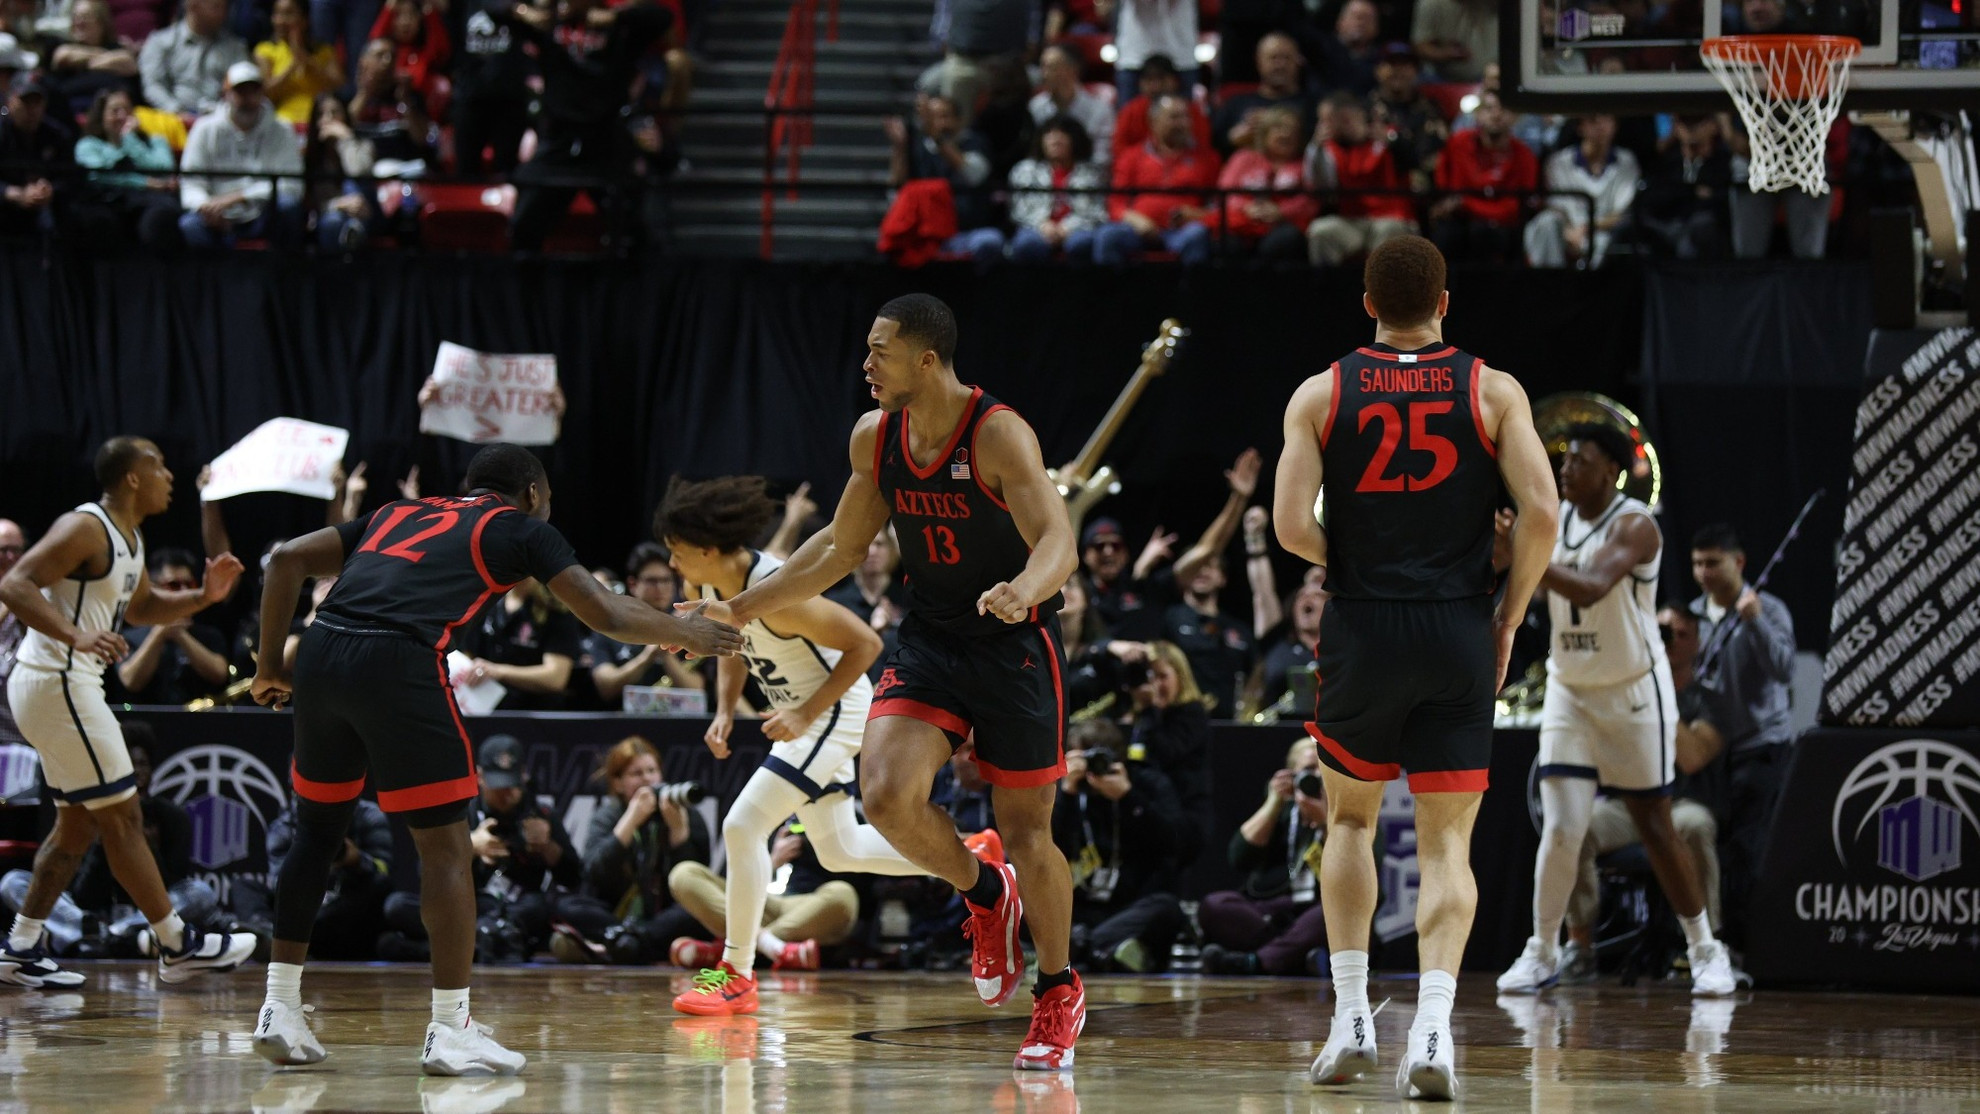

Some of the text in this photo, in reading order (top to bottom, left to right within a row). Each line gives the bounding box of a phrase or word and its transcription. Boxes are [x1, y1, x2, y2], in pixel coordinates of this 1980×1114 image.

[498, 358, 556, 385] JUST
[1360, 368, 1453, 393] SAUNDERS
[1853, 375, 1901, 442] NESS
[1354, 401, 1458, 492] 25
[895, 488, 971, 519] AZTECS
[357, 505, 460, 563] 12
[921, 524, 961, 565] 13
[1560, 631, 1601, 652] STATE
